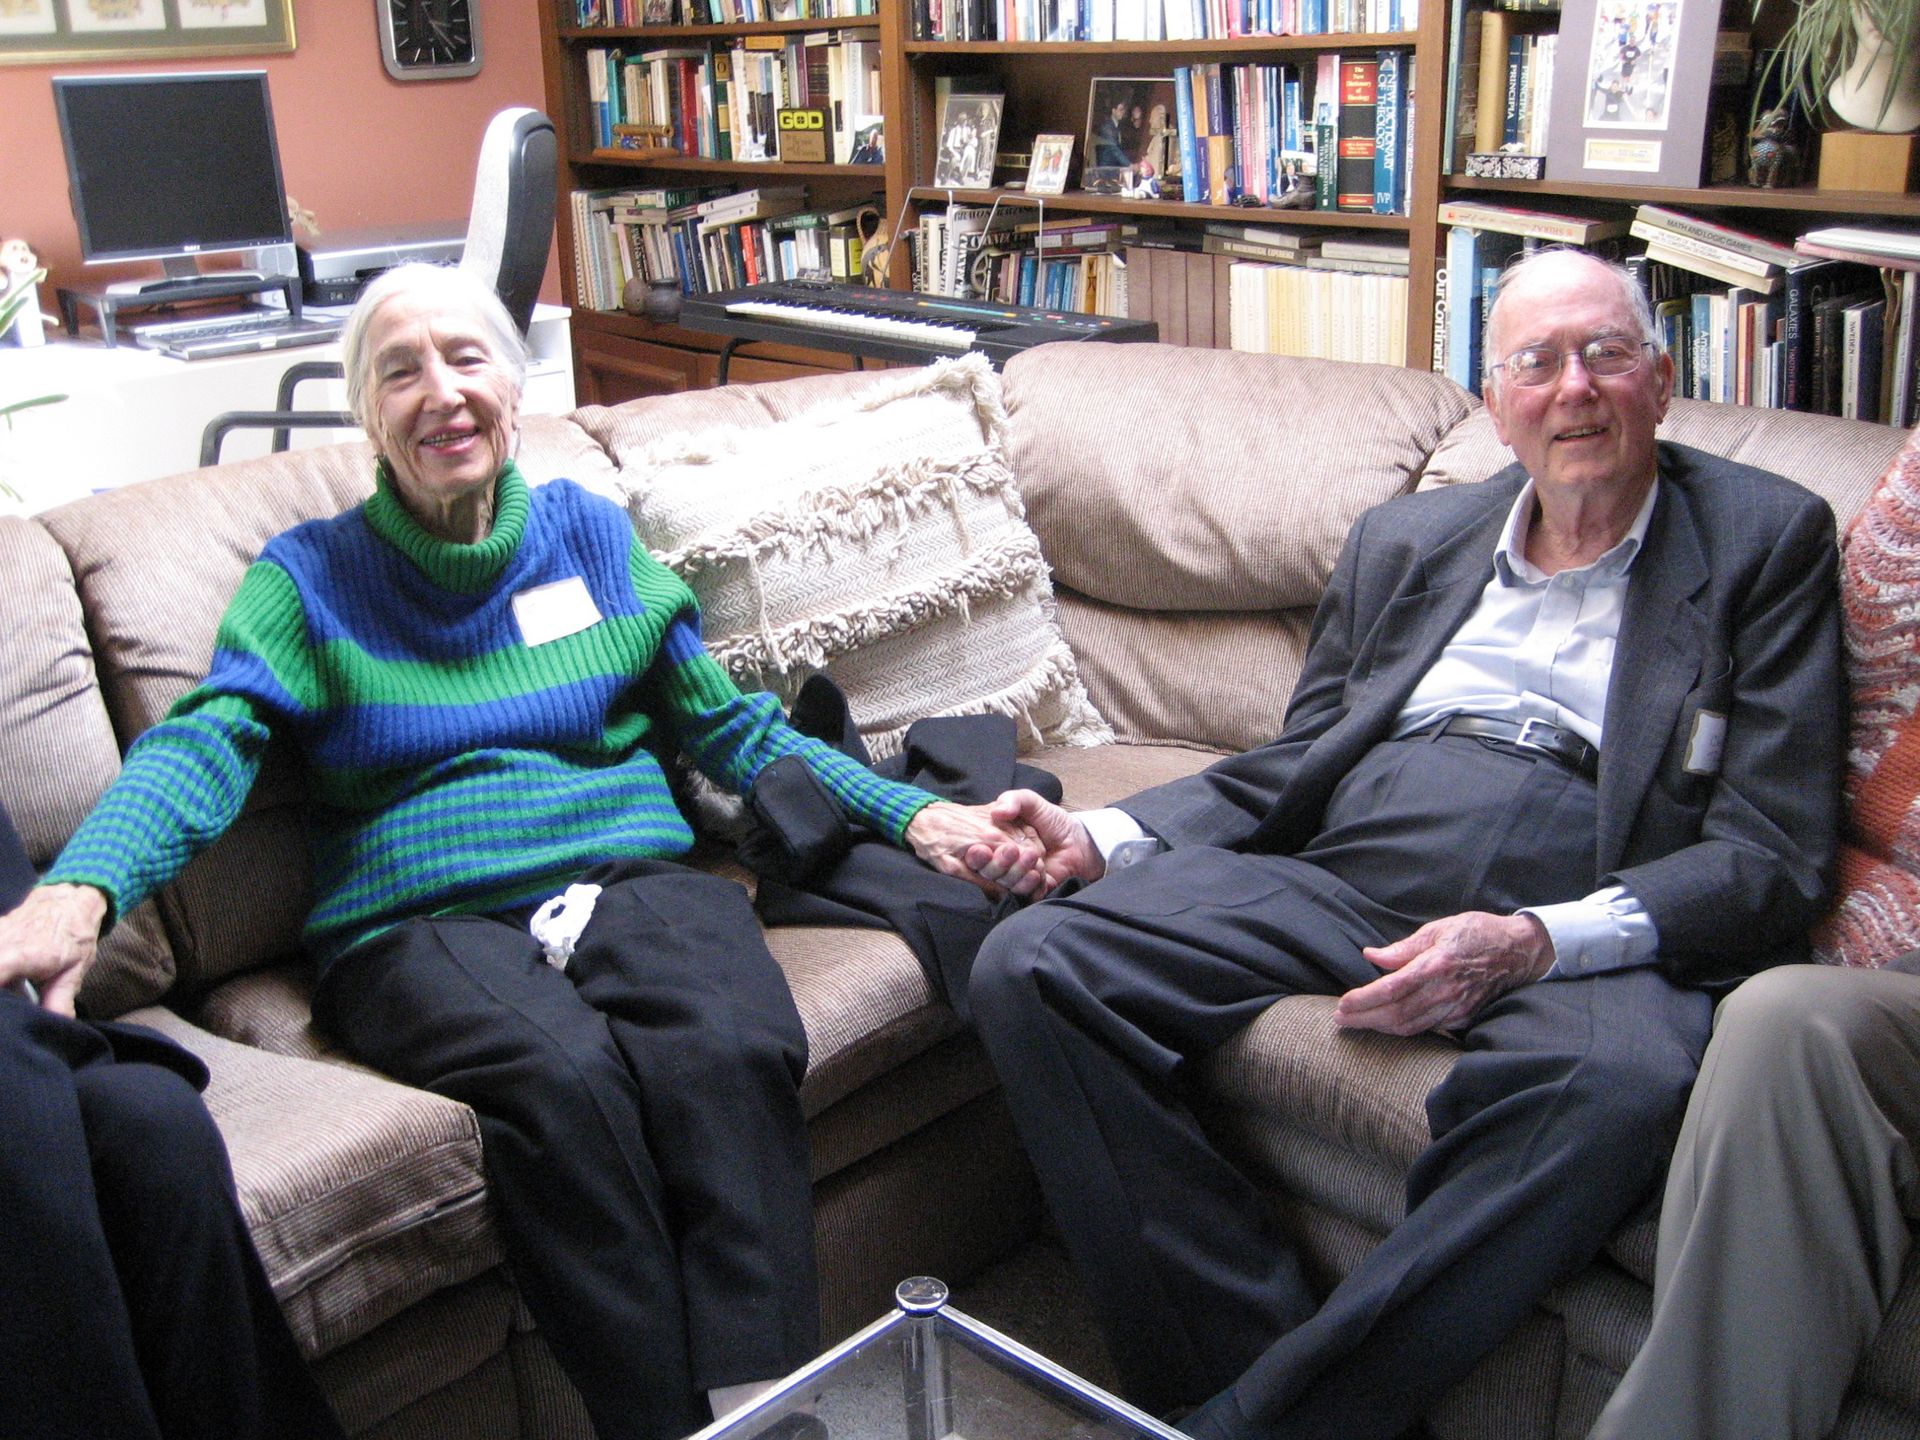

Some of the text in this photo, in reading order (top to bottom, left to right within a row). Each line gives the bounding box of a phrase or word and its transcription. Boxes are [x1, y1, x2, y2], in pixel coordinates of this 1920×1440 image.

[1375, 74, 1386, 151] OF THEOLOGY
[1507, 64, 1517, 120] PRINCIPIA
[1518, 64, 1529, 121] PRINCIPIA
[779, 111, 824, 129] GOD
[1384, 74, 1397, 169] NEW DICTIONARY
[1377, 192, 1391, 204] IVP
[1223, 242, 1231, 250] THE
[1267, 247, 1294, 259] EXPERIENCE
[1666, 219, 1753, 253] MATH AND LOGIC GAMES
[1433, 269, 1447, 373] Our Continent
[1481, 278, 1492, 322] Stanford
[1788, 289, 1799, 339] GALAXIES
[1700, 330, 1709, 376] America's
[1848, 321, 1856, 355] SWEDEN
[1692, 338, 1701, 398] Wonderlands
[1788, 347, 1797, 378] TIMOTHY
